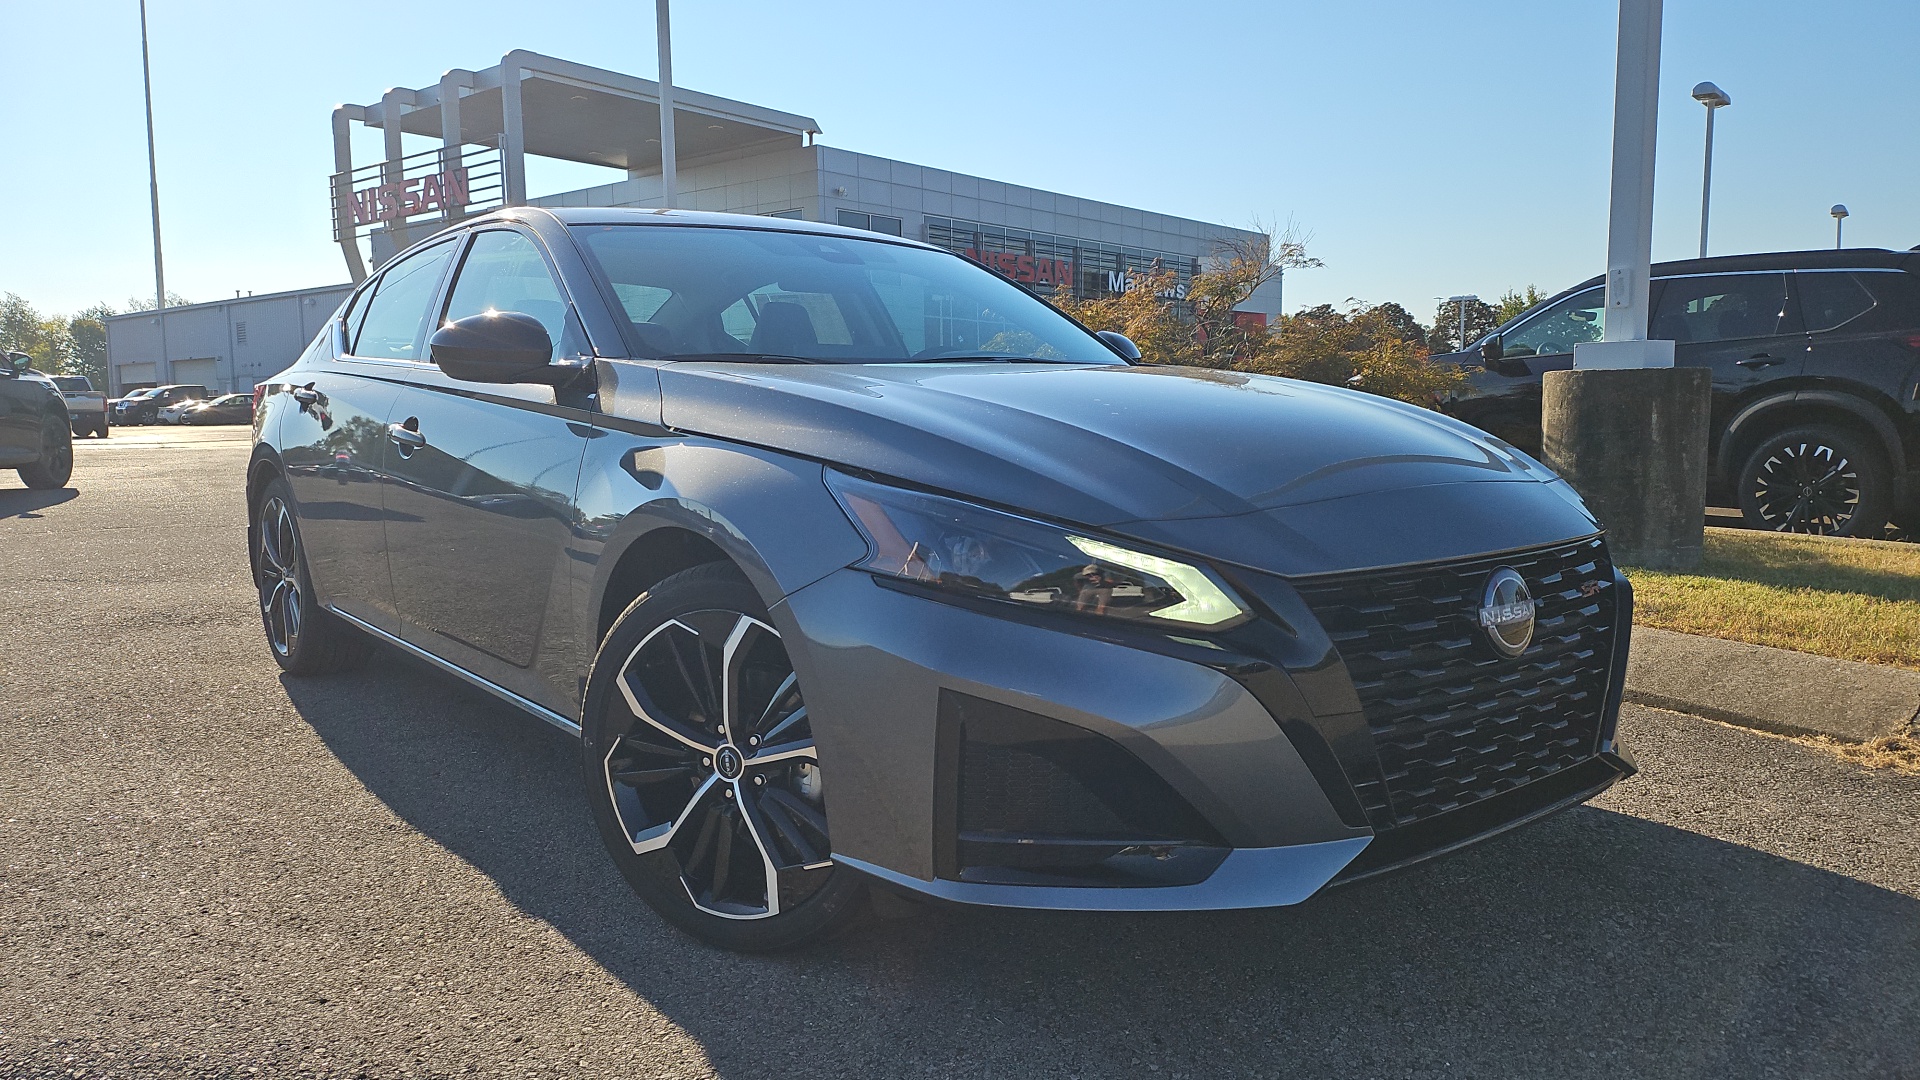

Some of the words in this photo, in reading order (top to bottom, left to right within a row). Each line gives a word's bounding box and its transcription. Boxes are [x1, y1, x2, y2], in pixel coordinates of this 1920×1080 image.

[346, 167, 468, 225] NISSAN
[965, 248, 1073, 286] NISSAN
[1482, 601, 1536, 625] NISSAN
